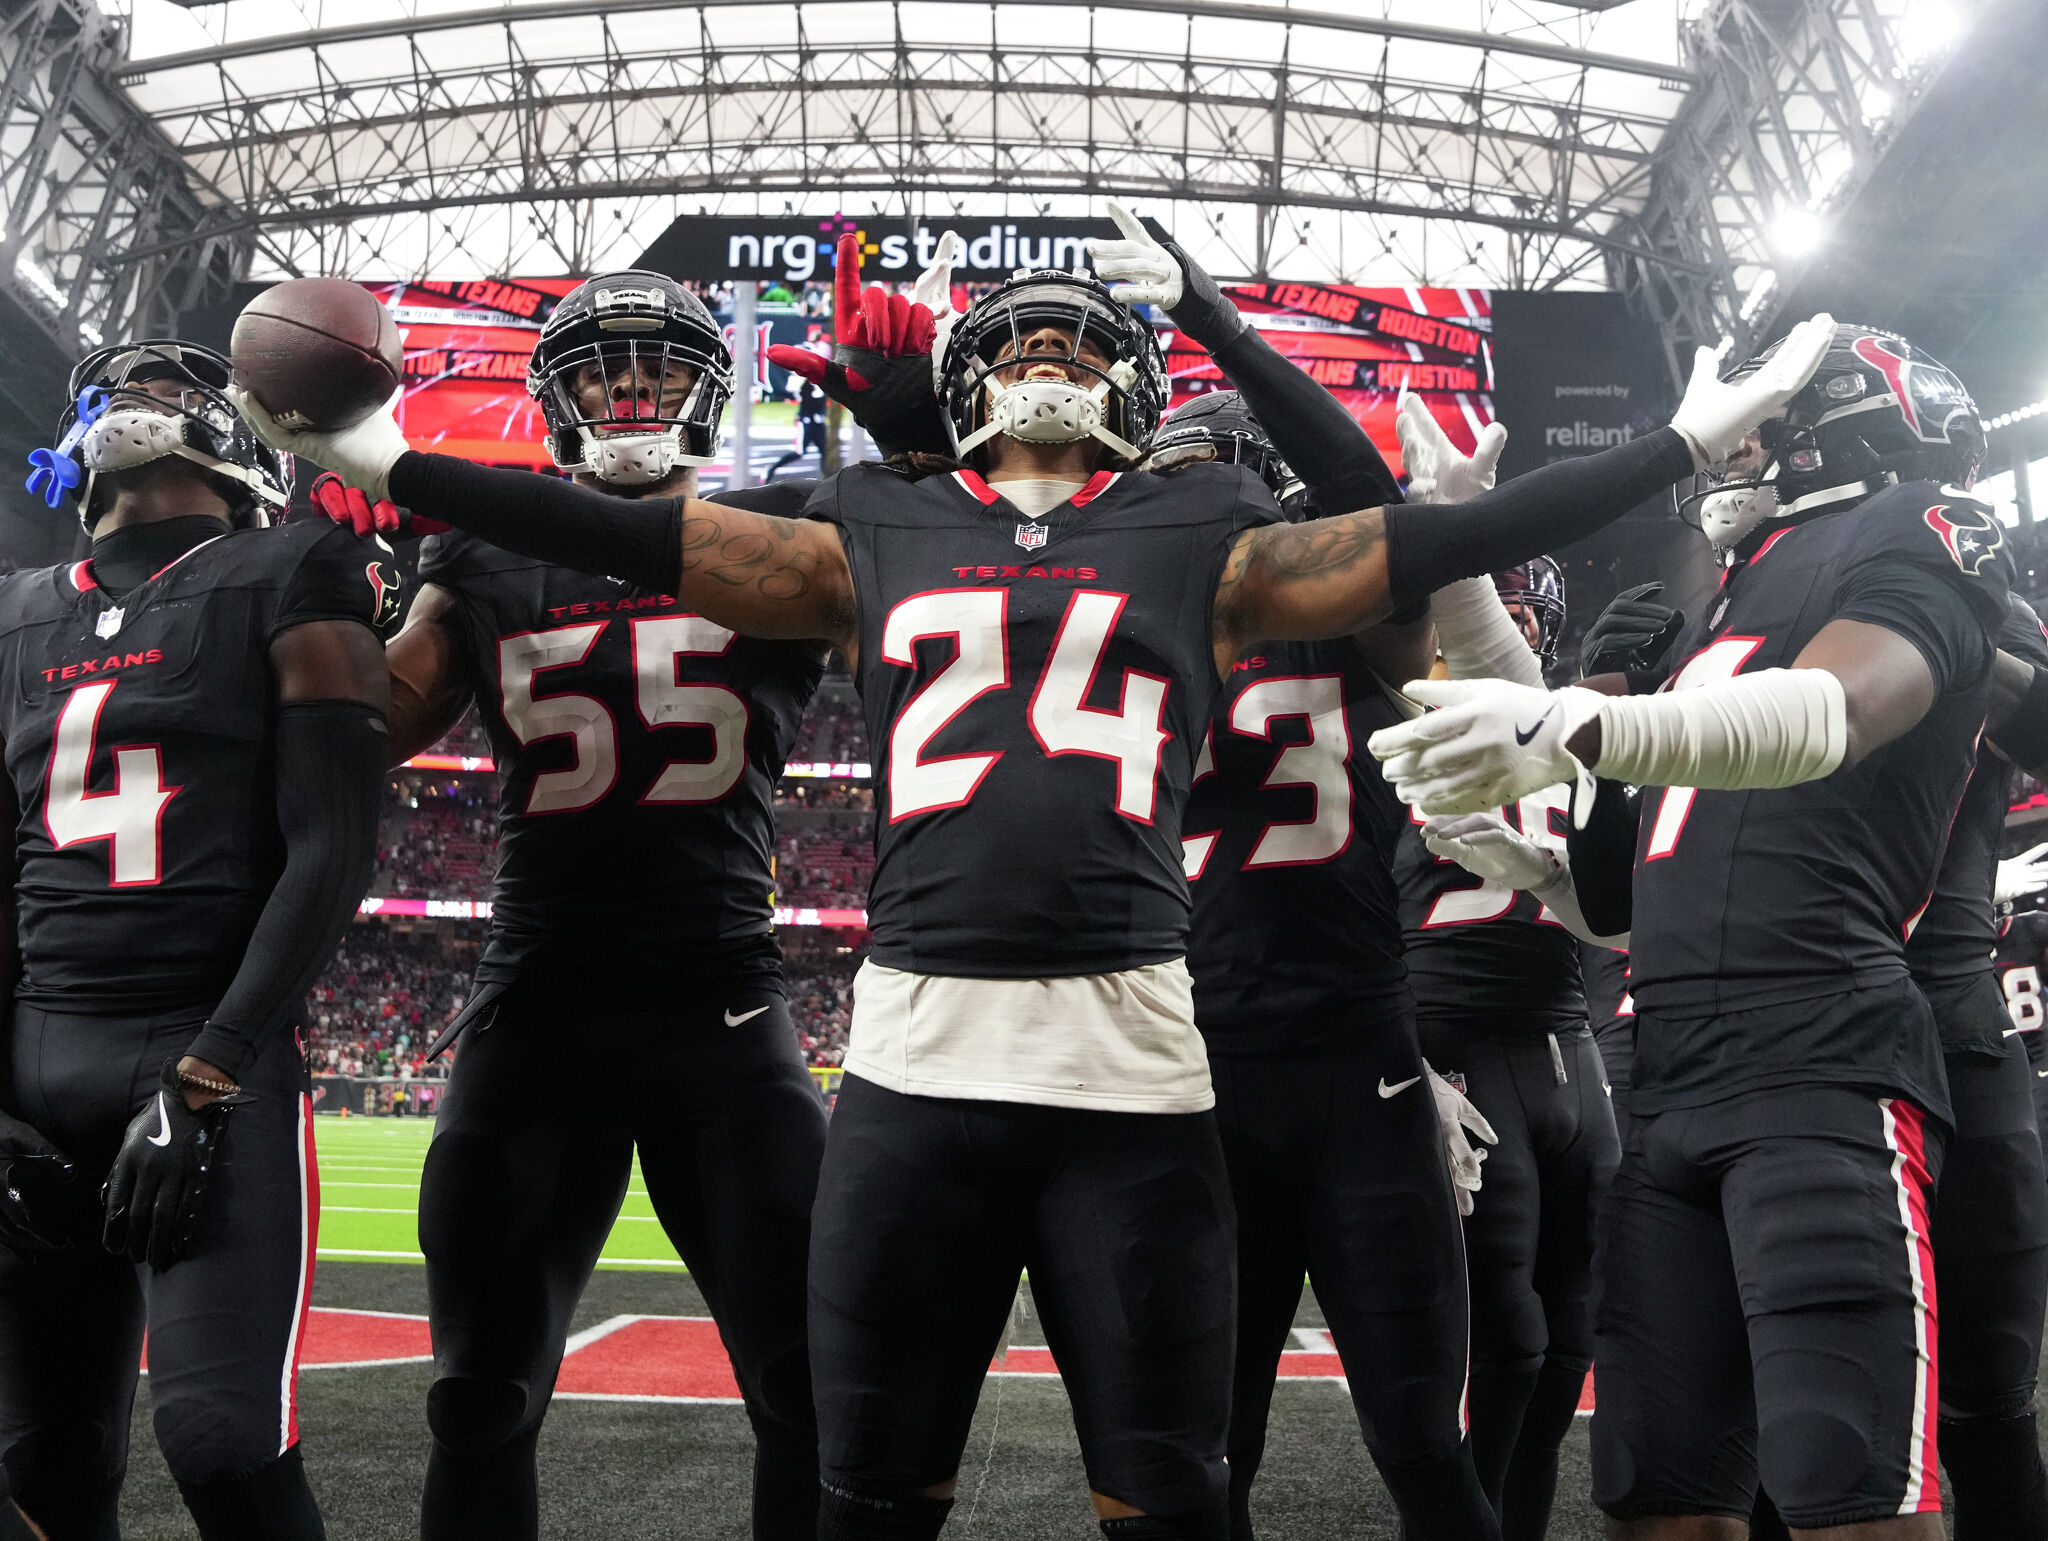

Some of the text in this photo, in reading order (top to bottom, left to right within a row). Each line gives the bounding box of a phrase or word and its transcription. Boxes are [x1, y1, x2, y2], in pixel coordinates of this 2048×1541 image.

[728, 234, 816, 281] nrg
[1272, 284, 1480, 355] TEXANS HOUSTON
[402, 351, 447, 376] TON
[1377, 362, 1478, 390] HOUSTON
[1555, 385, 1629, 399] powered by
[1545, 421, 1634, 447] reliant
[1021, 532, 1042, 545] NFL
[952, 565, 1098, 581] TEXANS
[547, 594, 677, 620] TEXANS
[42, 648, 164, 683] TEXANS
[496, 612, 752, 818] 55
[881, 586, 1175, 826] 24
[42, 678, 184, 888] 4
